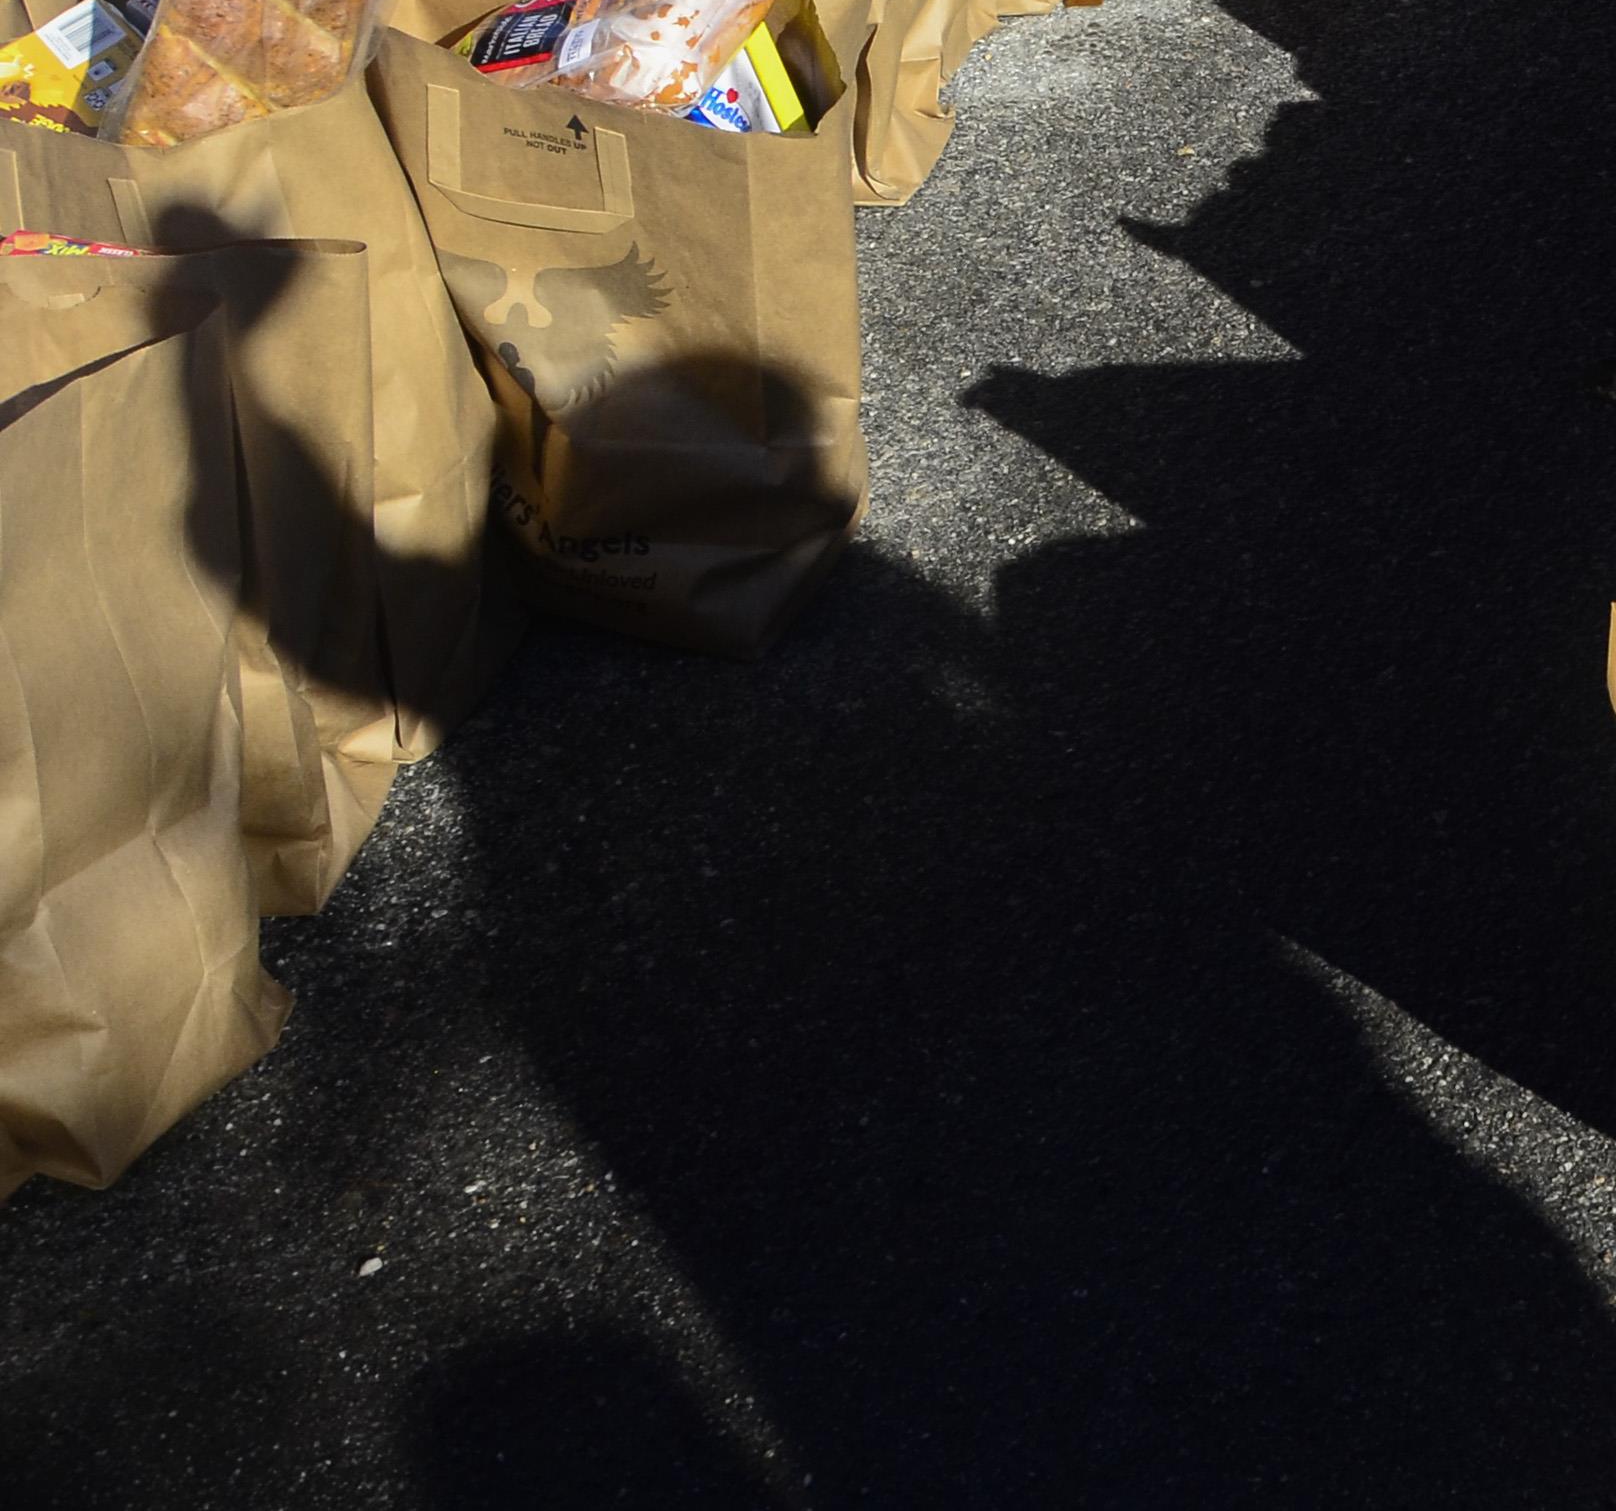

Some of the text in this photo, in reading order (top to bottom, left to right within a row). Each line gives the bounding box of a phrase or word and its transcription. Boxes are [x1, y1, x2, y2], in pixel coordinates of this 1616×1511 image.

[503, 14, 541, 57] ITALIAN
[522, 12, 559, 49] BREAD
[504, 126, 588, 152] PULL HANDLES UP
[525, 139, 568, 155] NOT OUT
